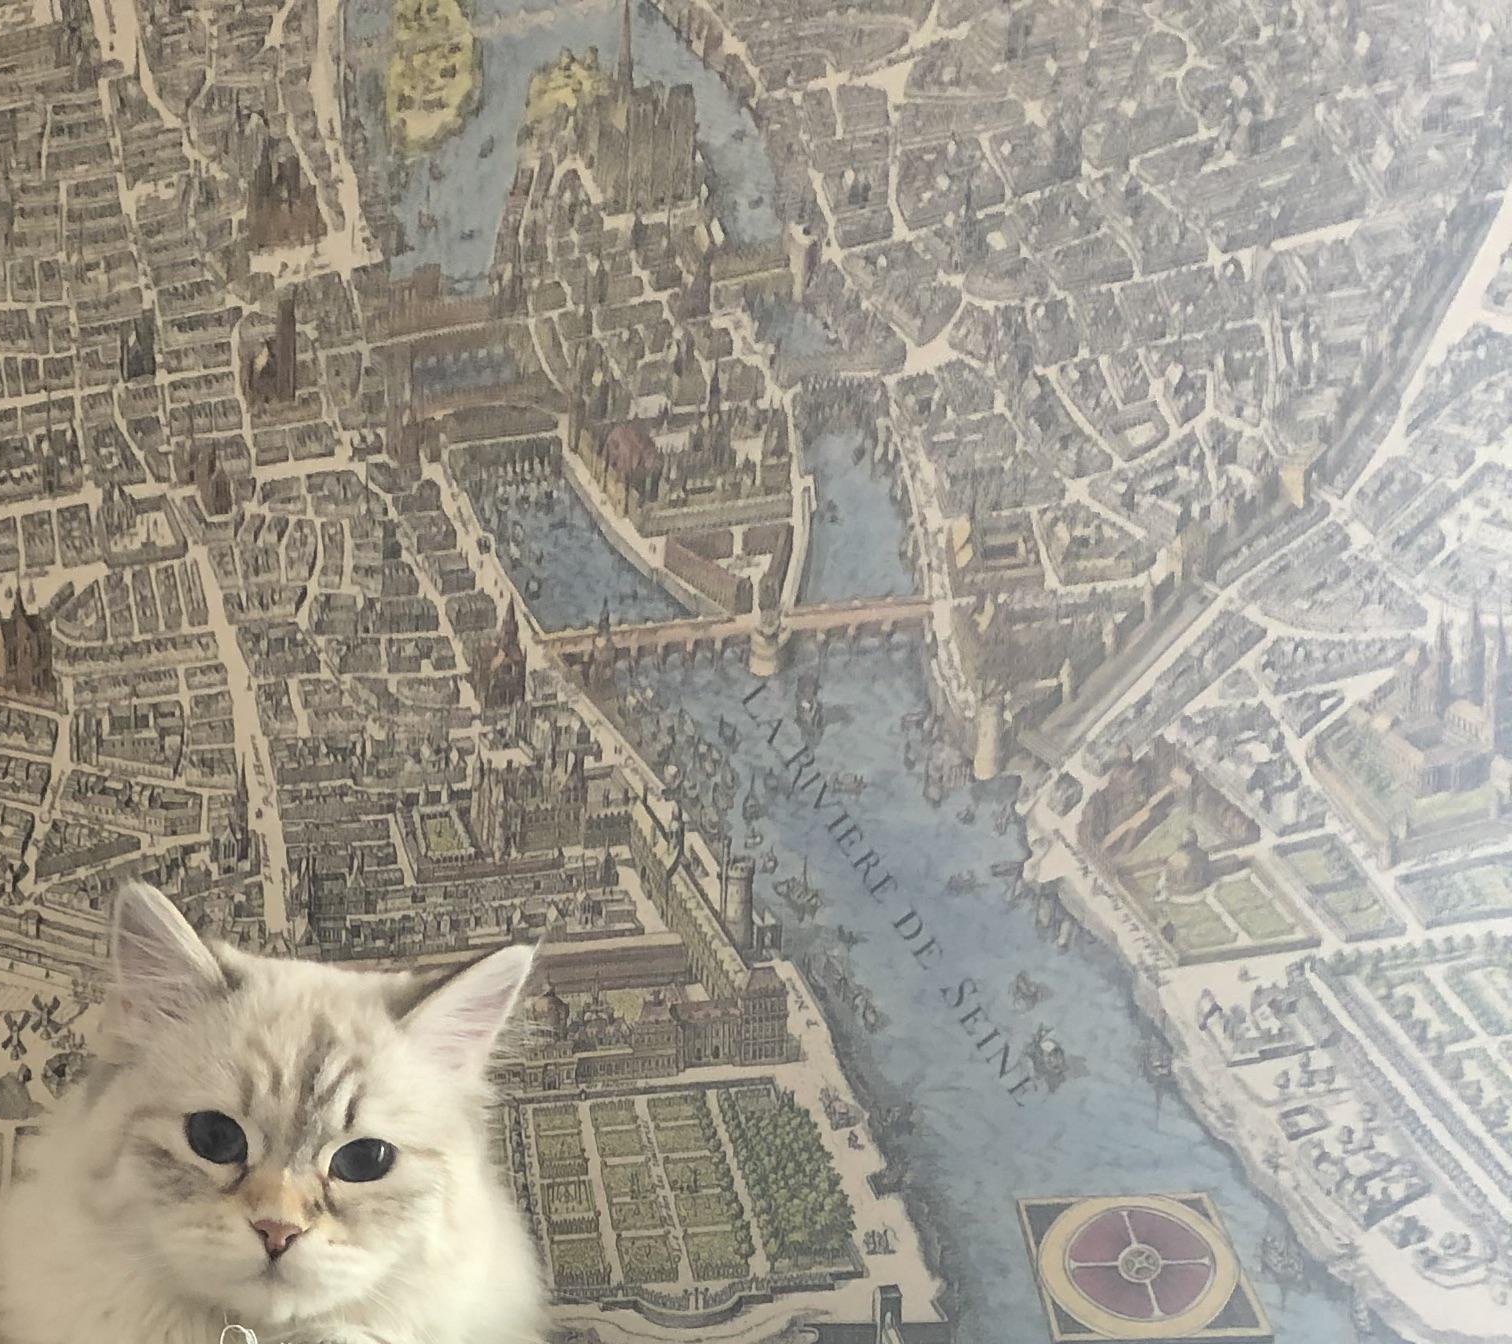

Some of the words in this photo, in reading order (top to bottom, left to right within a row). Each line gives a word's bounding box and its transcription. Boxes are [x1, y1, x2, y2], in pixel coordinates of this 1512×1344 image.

[742, 683, 783, 745] LA
[892, 905, 943, 970] DE
[940, 976, 1038, 1107] SEINE
